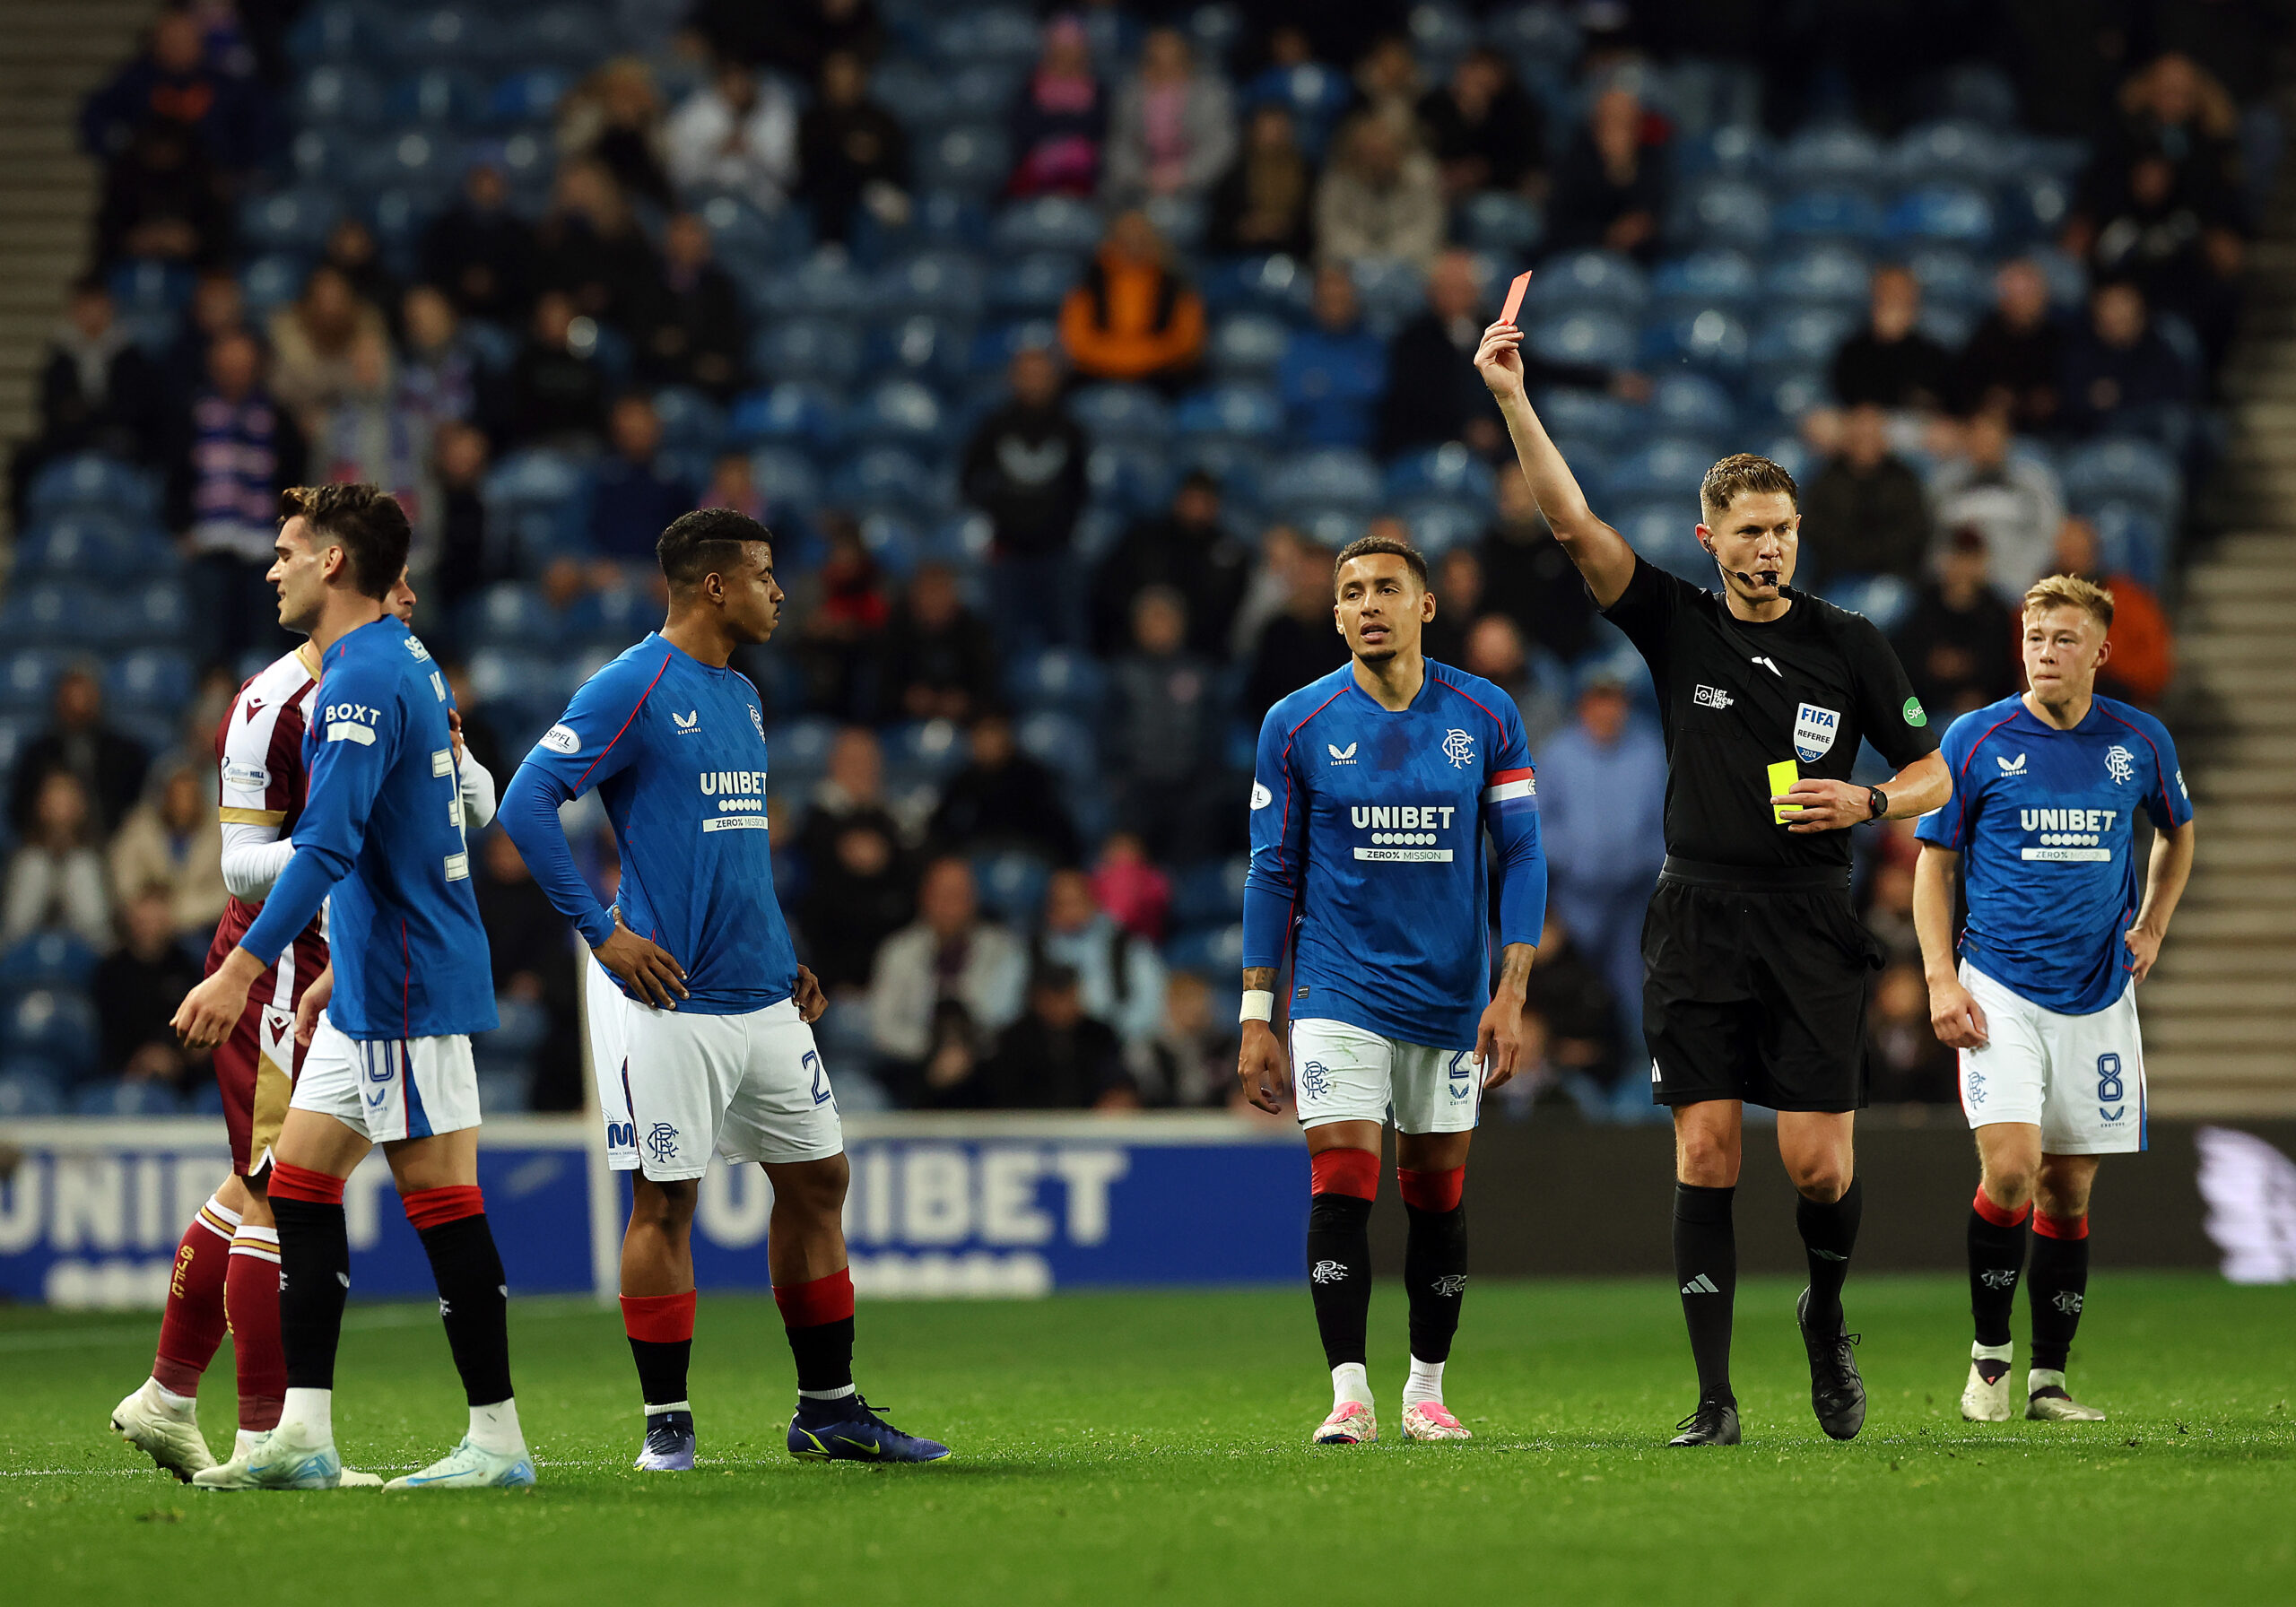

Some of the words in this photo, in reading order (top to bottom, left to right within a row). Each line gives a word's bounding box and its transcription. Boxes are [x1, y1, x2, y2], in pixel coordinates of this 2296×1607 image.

[326, 703, 381, 725] BOXT
[1801, 708, 1834, 728] FIFA
[547, 730, 570, 747] SPFL
[1797, 729, 1831, 744] REFEREE
[1801, 749, 1817, 759] 2024
[700, 771, 767, 795] UNIBET
[716, 818, 744, 829] ZERO%
[1351, 806, 1455, 830] UNIBET
[2021, 809, 2117, 831] UNIBET
[1367, 851, 1400, 859] ZERO%
[1404, 851, 1441, 860] MISSION
[2036, 851, 2068, 859] ZERO%
[2098, 1053, 2123, 1102] 8
[0, 1154, 391, 1254] UNIT
[699, 1149, 1128, 1249] UIBET
[171, 1245, 195, 1299] SJFC
